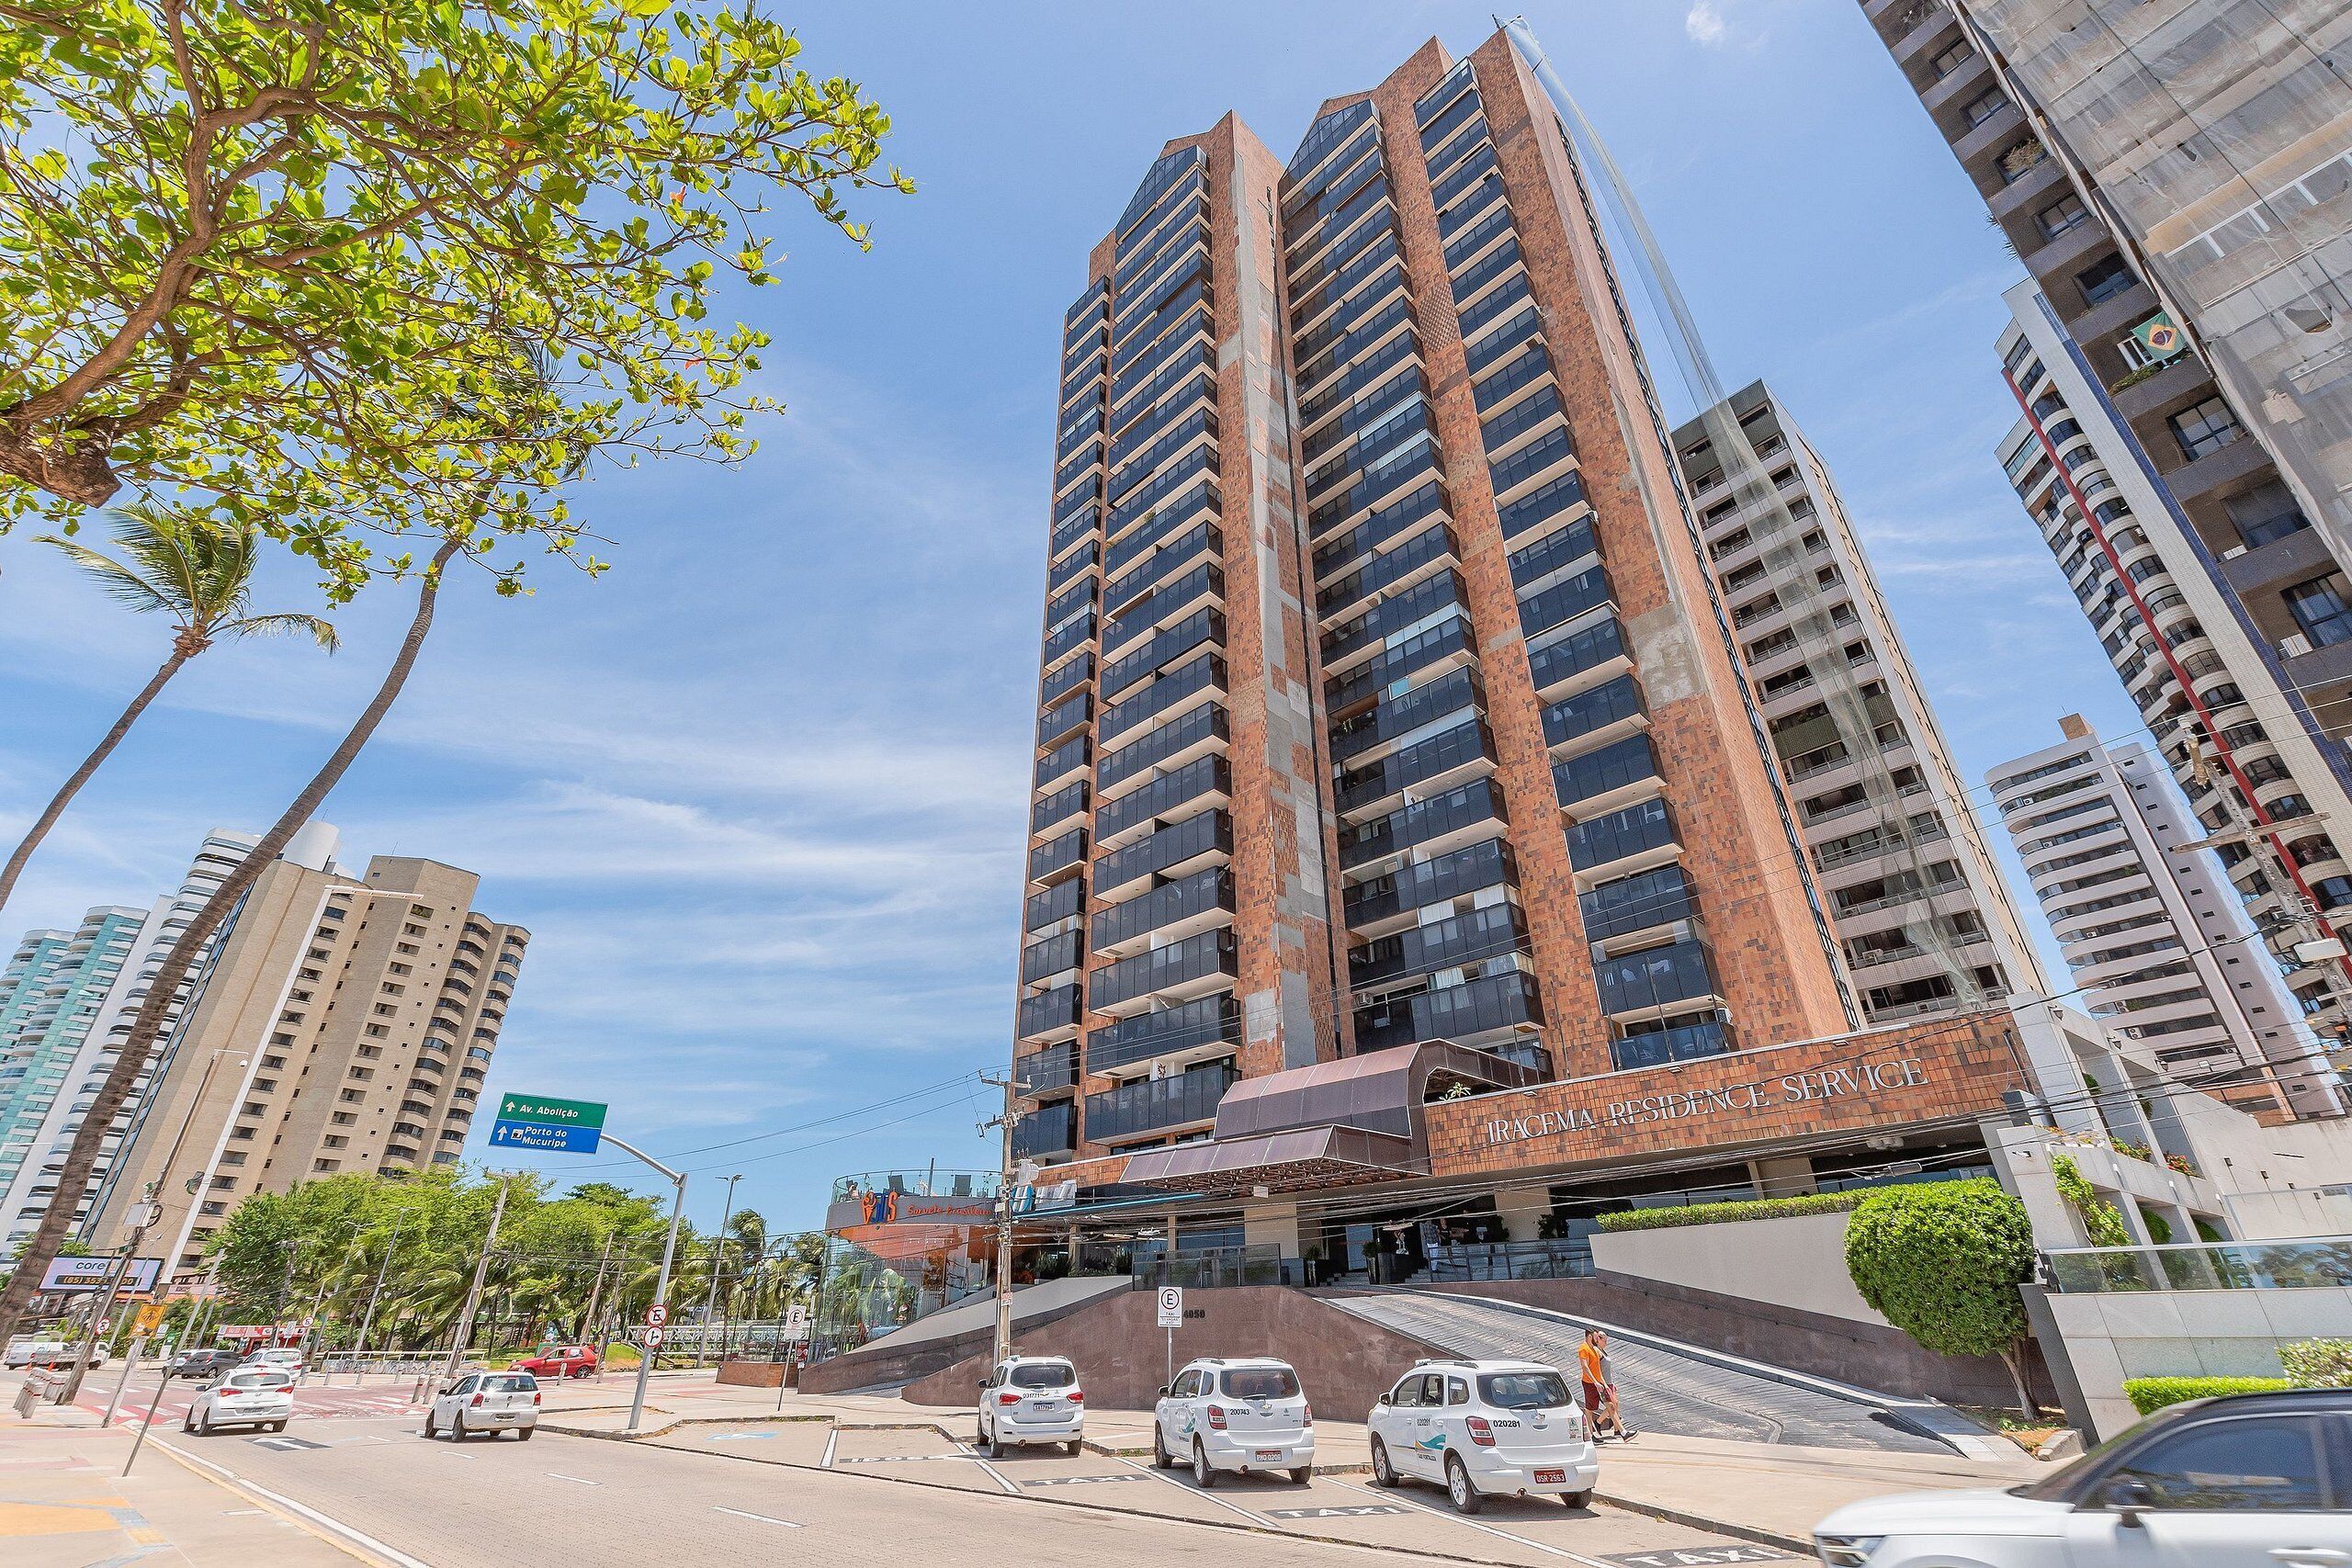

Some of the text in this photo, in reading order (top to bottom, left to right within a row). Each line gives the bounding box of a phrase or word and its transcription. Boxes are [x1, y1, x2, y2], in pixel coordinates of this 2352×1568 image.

[1487, 1057, 1928, 1144] IRACEMA RESIDENCE SERVICE
[518, 1104, 579, 1119] Av. Abolição
[525, 1126, 568, 1138] Porto do
[521, 1136, 567, 1148] Mucuripe
[1167, 1293, 1173, 1304] E
[1035, 1475, 1136, 1485] TAXI
[1276, 1506, 1402, 1517] TAXI
[1624, 1549, 1783, 1566] TAXI
